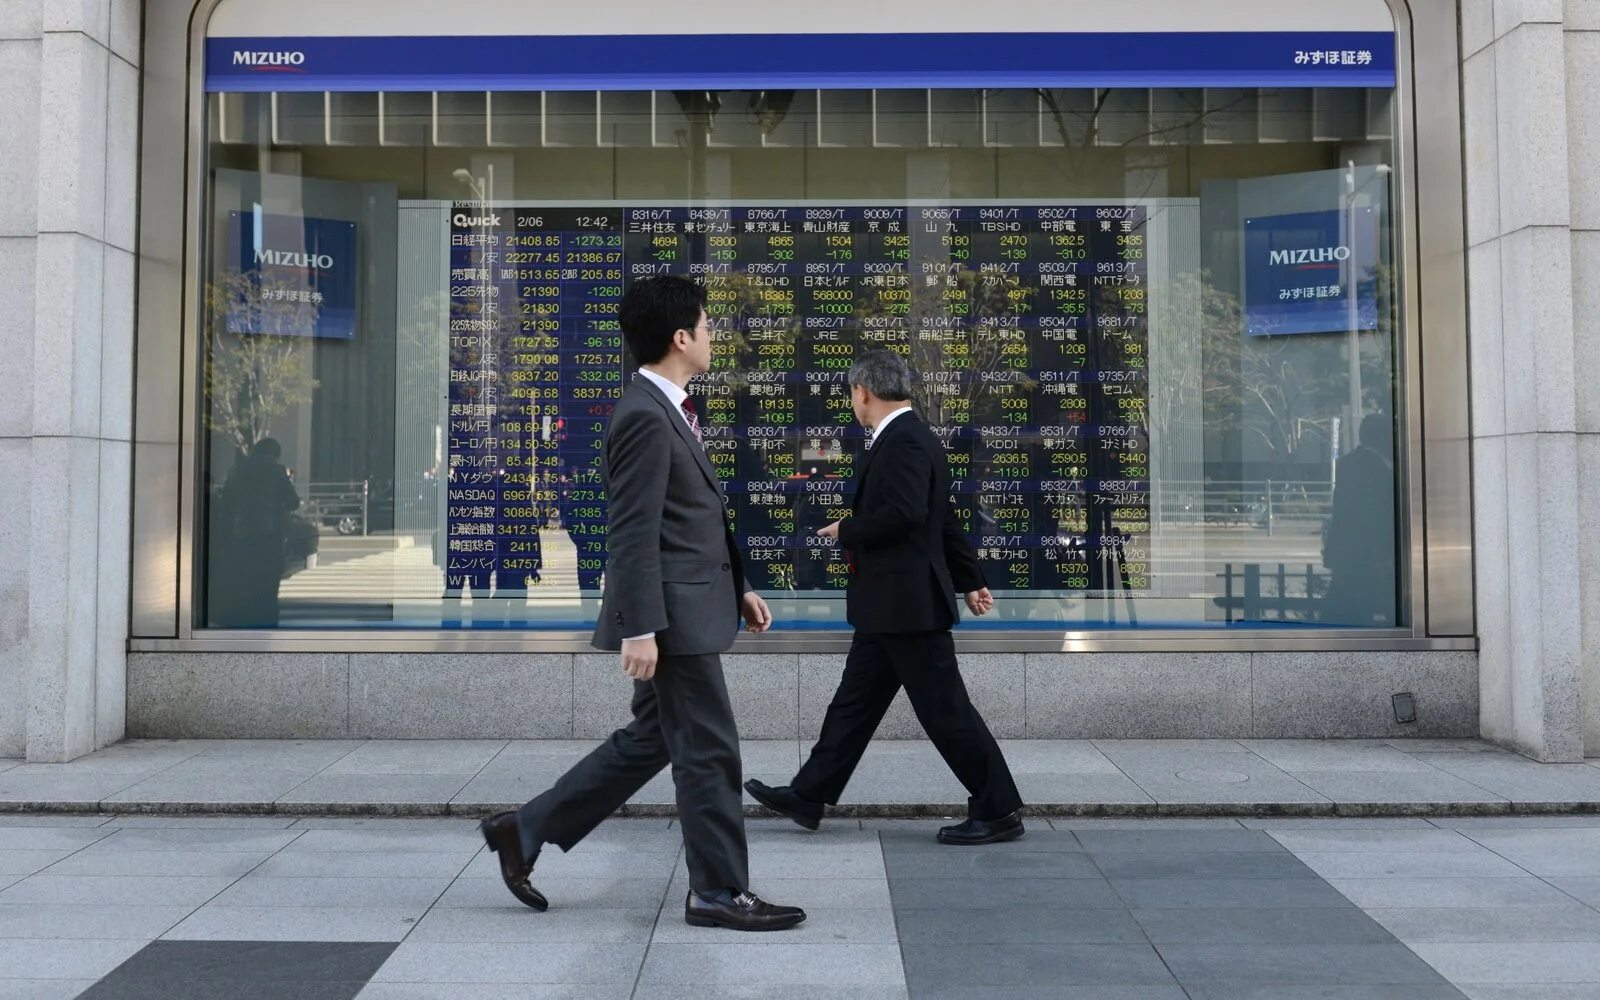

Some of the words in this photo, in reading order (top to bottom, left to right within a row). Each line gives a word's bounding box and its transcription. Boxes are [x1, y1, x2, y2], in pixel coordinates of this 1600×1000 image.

[233, 51, 305, 65] MIZUHO
[1294, 50, 1372, 65] みずほ証券
[632, 209, 671, 220] 8316/T
[690, 209, 729, 220] 8439/T
[747, 209, 787, 220] 8766/T
[806, 209, 845, 219] 8929/T
[864, 209, 903, 219] 9009/T
[922, 208, 961, 219] 9065/T
[980, 208, 1019, 219] 9401/T
[1038, 208, 1078, 219] 9502/T
[1096, 208, 1136, 219] 9602/T
[453, 213, 501, 228] Quick
[517, 217, 543, 227] 2/06
[576, 217, 608, 227] 12:42
[1041, 220, 1076, 232] 中部電
[629, 221, 676, 233] 三井住友
[684, 221, 736, 233] 東センチュリー
[745, 221, 792, 233] 東京海上
[803, 221, 850, 233] 青山財産
[980, 222, 1021, 232] TBSHD
[452, 234, 499, 247] 日経平均
[506, 236, 560, 246] 21408.85
[570, 236, 621, 245] -1273.23
[652, 236, 678, 247] 4694
[710, 236, 737, 247] 5800
[768, 236, 794, 246] 4865
[826, 236, 852, 246] 1504
[884, 236, 910, 246] 3425
[942, 236, 969, 246] 5180
[1000, 236, 1027, 246] 2470
[1050, 236, 1084, 246] 1362.5
[1116, 236, 1143, 246] 3435
[254, 249, 333, 269] MIZUHO
[505, 252, 560, 263] 22277.45
[567, 252, 621, 263] 21386.67
[652, 250, 676, 260] -241
[710, 250, 737, 260] -150
[768, 250, 794, 260] -302
[826, 250, 852, 259] -176
[884, 250, 910, 259] -145
[1000, 249, 1027, 259] -139
[1269, 246, 1350, 265] MIZUHO
[632, 263, 671, 274] 8331/T
[690, 263, 729, 274] 8591/T
[747, 263, 787, 274] 8795/T
[806, 263, 845, 273] 8951/T
[864, 263, 903, 273] 9020/T
[922, 263, 961, 273] 9101/T
[980, 263, 1020, 273] 9412/T
[1038, 263, 1078, 273] 9503/T
[1097, 263, 1136, 273] 9613/T
[452, 268, 489, 281] 売買高
[581, 269, 621, 280] 205.85
[694, 276, 727, 287] オリックス
[804, 276, 850, 287] 日本ビルF
[860, 276, 910, 287] JR東日本
[1040, 275, 1077, 286] 関西電
[1094, 275, 1140, 286] NTTデータ
[262, 288, 324, 303] みずほ証券
[451, 286, 499, 297] 225先物
[523, 286, 559, 297] 21390
[587, 286, 621, 296] -1260
[813, 290, 853, 300] 568000
[878, 290, 912, 300] 10370
[942, 290, 967, 300] 2491
[1007, 290, 1027, 300] 497
[1050, 290, 1085, 300] 1342.5
[1279, 285, 1341, 300] みずほ証券
[523, 303, 559, 314] 21830
[584, 303, 619, 313] 21350
[451, 319, 498, 331] 225先物SGX
[523, 320, 559, 330] 21390
[587, 320, 621, 330] -1265
[747, 317, 788, 328] 8801/T
[806, 317, 845, 328] 8952/T
[864, 317, 904, 327] 9021/T
[922, 317, 962, 327] 9104/T
[980, 317, 1020, 327] 9413/T
[1039, 317, 1078, 327] 9504/T
[1097, 317, 1137, 327] 9681/T
[750, 330, 786, 341] 三井不
[814, 331, 838, 341] JRE
[860, 330, 909, 341] JR西日本
[919, 330, 966, 341] 商船三井
[978, 330, 1026, 341] テレ東HD
[1042, 329, 1077, 341] 中国電
[1102, 330, 1132, 340] ドーム
[451, 336, 492, 348] TOPIX
[512, 337, 559, 347] 1727.55
[583, 337, 621, 347] -96.19
[759, 344, 794, 354] 2585.0
[813, 344, 853, 354] 540000
[1002, 344, 1027, 354] 2654
[1060, 344, 1085, 354] 1208
[512, 354, 559, 364] 1790.08
[574, 354, 621, 364] 1725.74
[451, 370, 497, 382] 日経JQ平均
[511, 371, 559, 381] 3837.20
[576, 371, 620, 381] -332.06
[747, 371, 787, 382] 8802/T
[806, 371, 845, 382] 9001/T
[923, 371, 962, 381] 9107/T
[981, 371, 1021, 381] 9432/T
[1040, 371, 1079, 381] 9511/T
[1098, 371, 1138, 381] 9735/T
[511, 388, 559, 398] 4096.68
[573, 388, 621, 398] 3837.15
[689, 384, 730, 396] 野村HD
[749, 384, 786, 396] 菱地所
[924, 384, 960, 395] 川崎船
[989, 385, 1014, 394] NTT
[1041, 383, 1078, 395] 沖縄電
[1102, 384, 1132, 395] セコム
[450, 404, 497, 416] 長期国債
[519, 405, 558, 415] 150.58
[706, 400, 735, 409] 655.6
[759, 400, 794, 409] 1913.5
[451, 420, 490, 432] ドル/円
[747, 426, 787, 437] 8803/T
[981, 426, 1021, 436] 9433/T
[1040, 426, 1080, 436] 9531/T
[1099, 426, 1138, 436] 9766/T
[450, 438, 497, 449] ユーロ/円
[749, 439, 786, 450] 平和不
[986, 440, 1018, 449] KDDI
[1043, 438, 1077, 450] 東ガス
[1100, 439, 1138, 450] コナミHD
[450, 455, 497, 467] 豪ドル/円
[768, 454, 794, 464] 1965
[1119, 453, 1146, 463] 5440
[748, 481, 787, 491] 8804/T
[981, 481, 1021, 491] 9437/T
[1099, 480, 1139, 491] 9983/T
[449, 490, 496, 500] NASDAQ
[750, 494, 786, 505] 東建物
[808, 494, 843, 505] 小田急
[980, 493, 1023, 504] NTTドコモ
[449, 507, 495, 518] ハンセン指数
[503, 507, 558, 518] 30860.12
[768, 509, 794, 519] 1664
[993, 508, 1029, 519] 2637.0
[449, 523, 495, 536] 上海総合指数
[449, 539, 496, 552] 韓国総合
[748, 536, 787, 546] 8830/T
[982, 535, 1022, 546] 9501/T
[750, 549, 786, 560] 住友不
[977, 548, 1028, 560] 東電力HD
[449, 557, 496, 569] ムンバイ
[1009, 563, 1029, 574] 422
[1055, 563, 1089, 573] 15370
